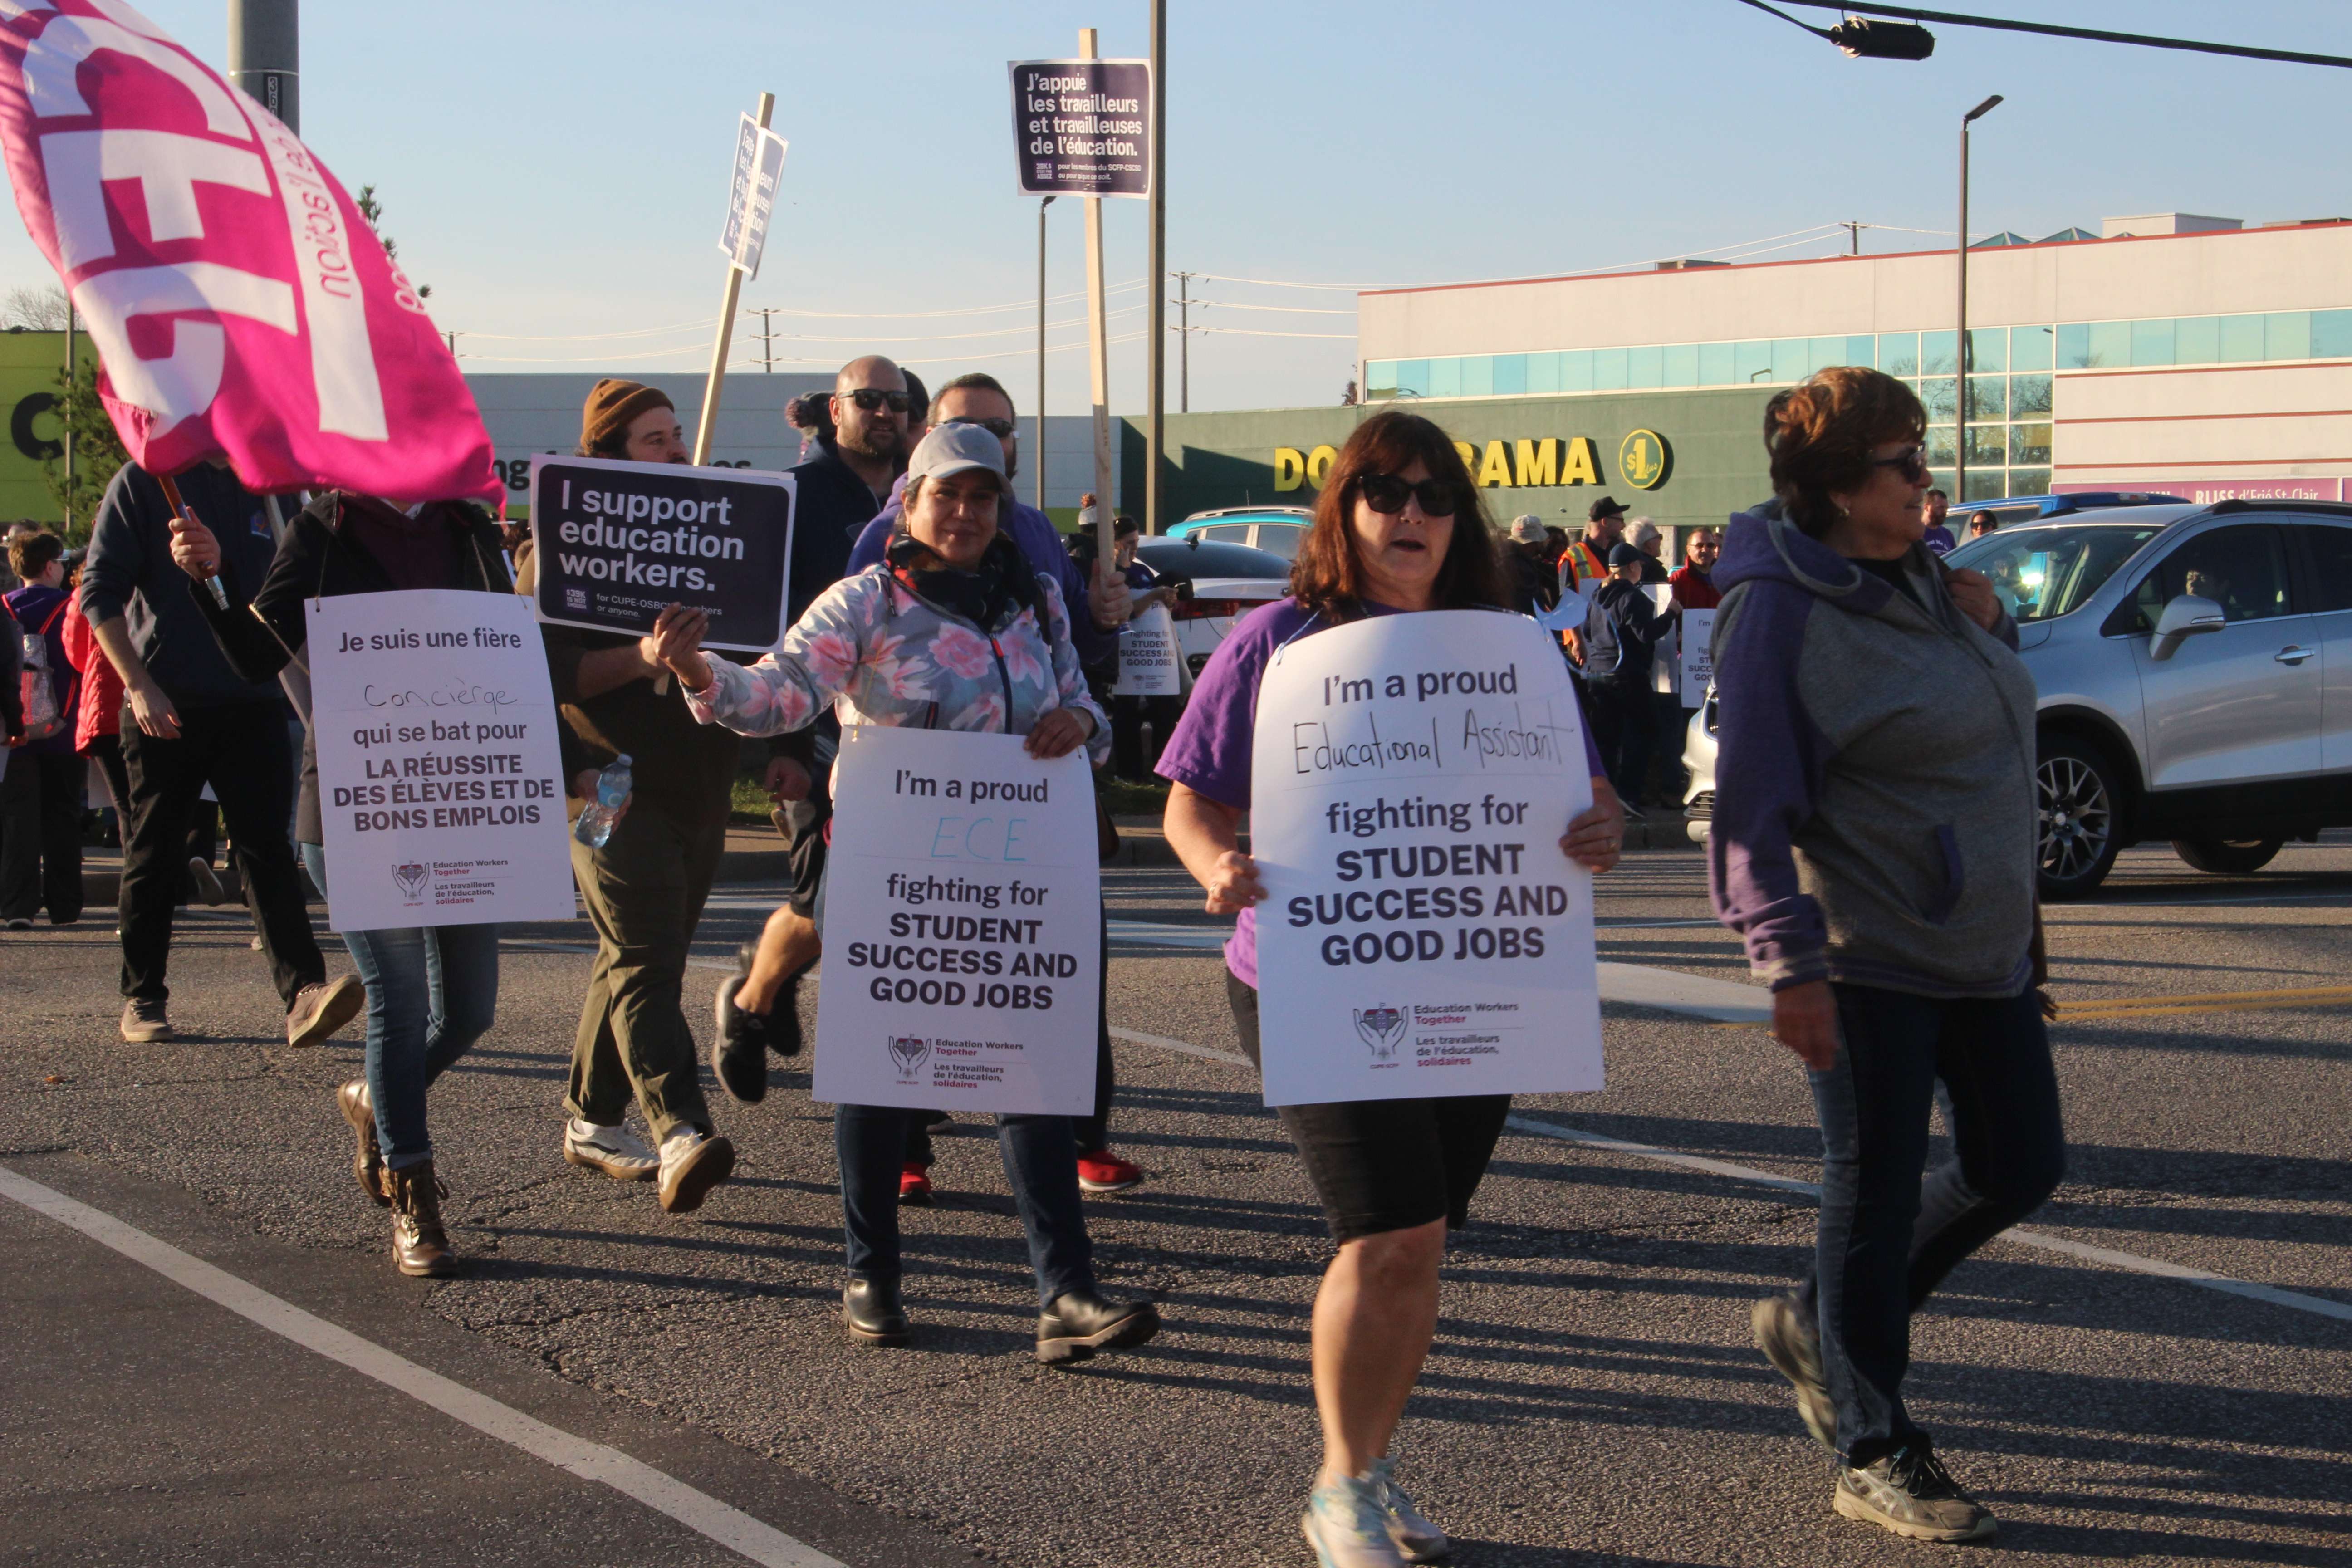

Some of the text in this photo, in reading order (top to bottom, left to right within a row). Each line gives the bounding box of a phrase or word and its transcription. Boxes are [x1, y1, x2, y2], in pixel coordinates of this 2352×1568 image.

[1027, 73, 1086, 94] J'appuie
[1028, 94, 1138, 113] les travailleurs
[1029, 116, 1142, 135] et travailleuses
[1030, 137, 1137, 156] de l'éducation.
[562, 480, 732, 525] I support
[2195, 490, 2235, 504] RLISS
[560, 516, 744, 560] education
[559, 553, 715, 591] workers.
[596, 593, 608, 602] for
[611, 595, 671, 610] CUPE-OSBC
[608, 607, 641, 617] anyone.
[339, 627, 522, 653] Je suis une fière
[1324, 663, 1518, 706] I'm a proud
[353, 720, 527, 748] qui se bat pour
[1294, 701, 1574, 774] Educational Assistant
[366, 751, 522, 779] LA RÉUSSITE
[333, 778, 554, 807] DES ÉLÈVES ET DE
[896, 770, 1048, 804] I'm a proud
[354, 805, 541, 832] BONS EMPLOIS
[1326, 794, 1528, 838] fighting for
[931, 817, 1027, 861] ECE
[433, 860, 475, 868] Education
[434, 868, 470, 877] Together
[1336, 843, 1524, 882] STUDENT
[447, 889, 494, 897] l'éducation,
[451, 881, 495, 889] travailleurs
[887, 873, 1049, 909] fighting for
[436, 897, 474, 905] solidaires
[1288, 885, 1568, 927] SUCCESS AND
[889, 912, 1043, 944] STUDENT
[1322, 927, 1545, 966] GOOD JOBS
[847, 942, 1078, 978] SUCCESS AND
[870, 977, 1053, 1010] GOOD JOBS
[1414, 1002, 1518, 1014] Education Workers
[1415, 1015, 1466, 1026] Together
[936, 1039, 1024, 1050] Education Workers
[1416, 1034, 1500, 1045] Les travailleurs
[936, 1047, 977, 1056] Together
[1416, 1045, 1499, 1056] de l'éducation,
[934, 1063, 1004, 1073] Les travailleurs
[1417, 1057, 1471, 1067] solidaires
[933, 1080, 977, 1089] solidaires
[948, 1072, 1002, 1082] l'éducation,
